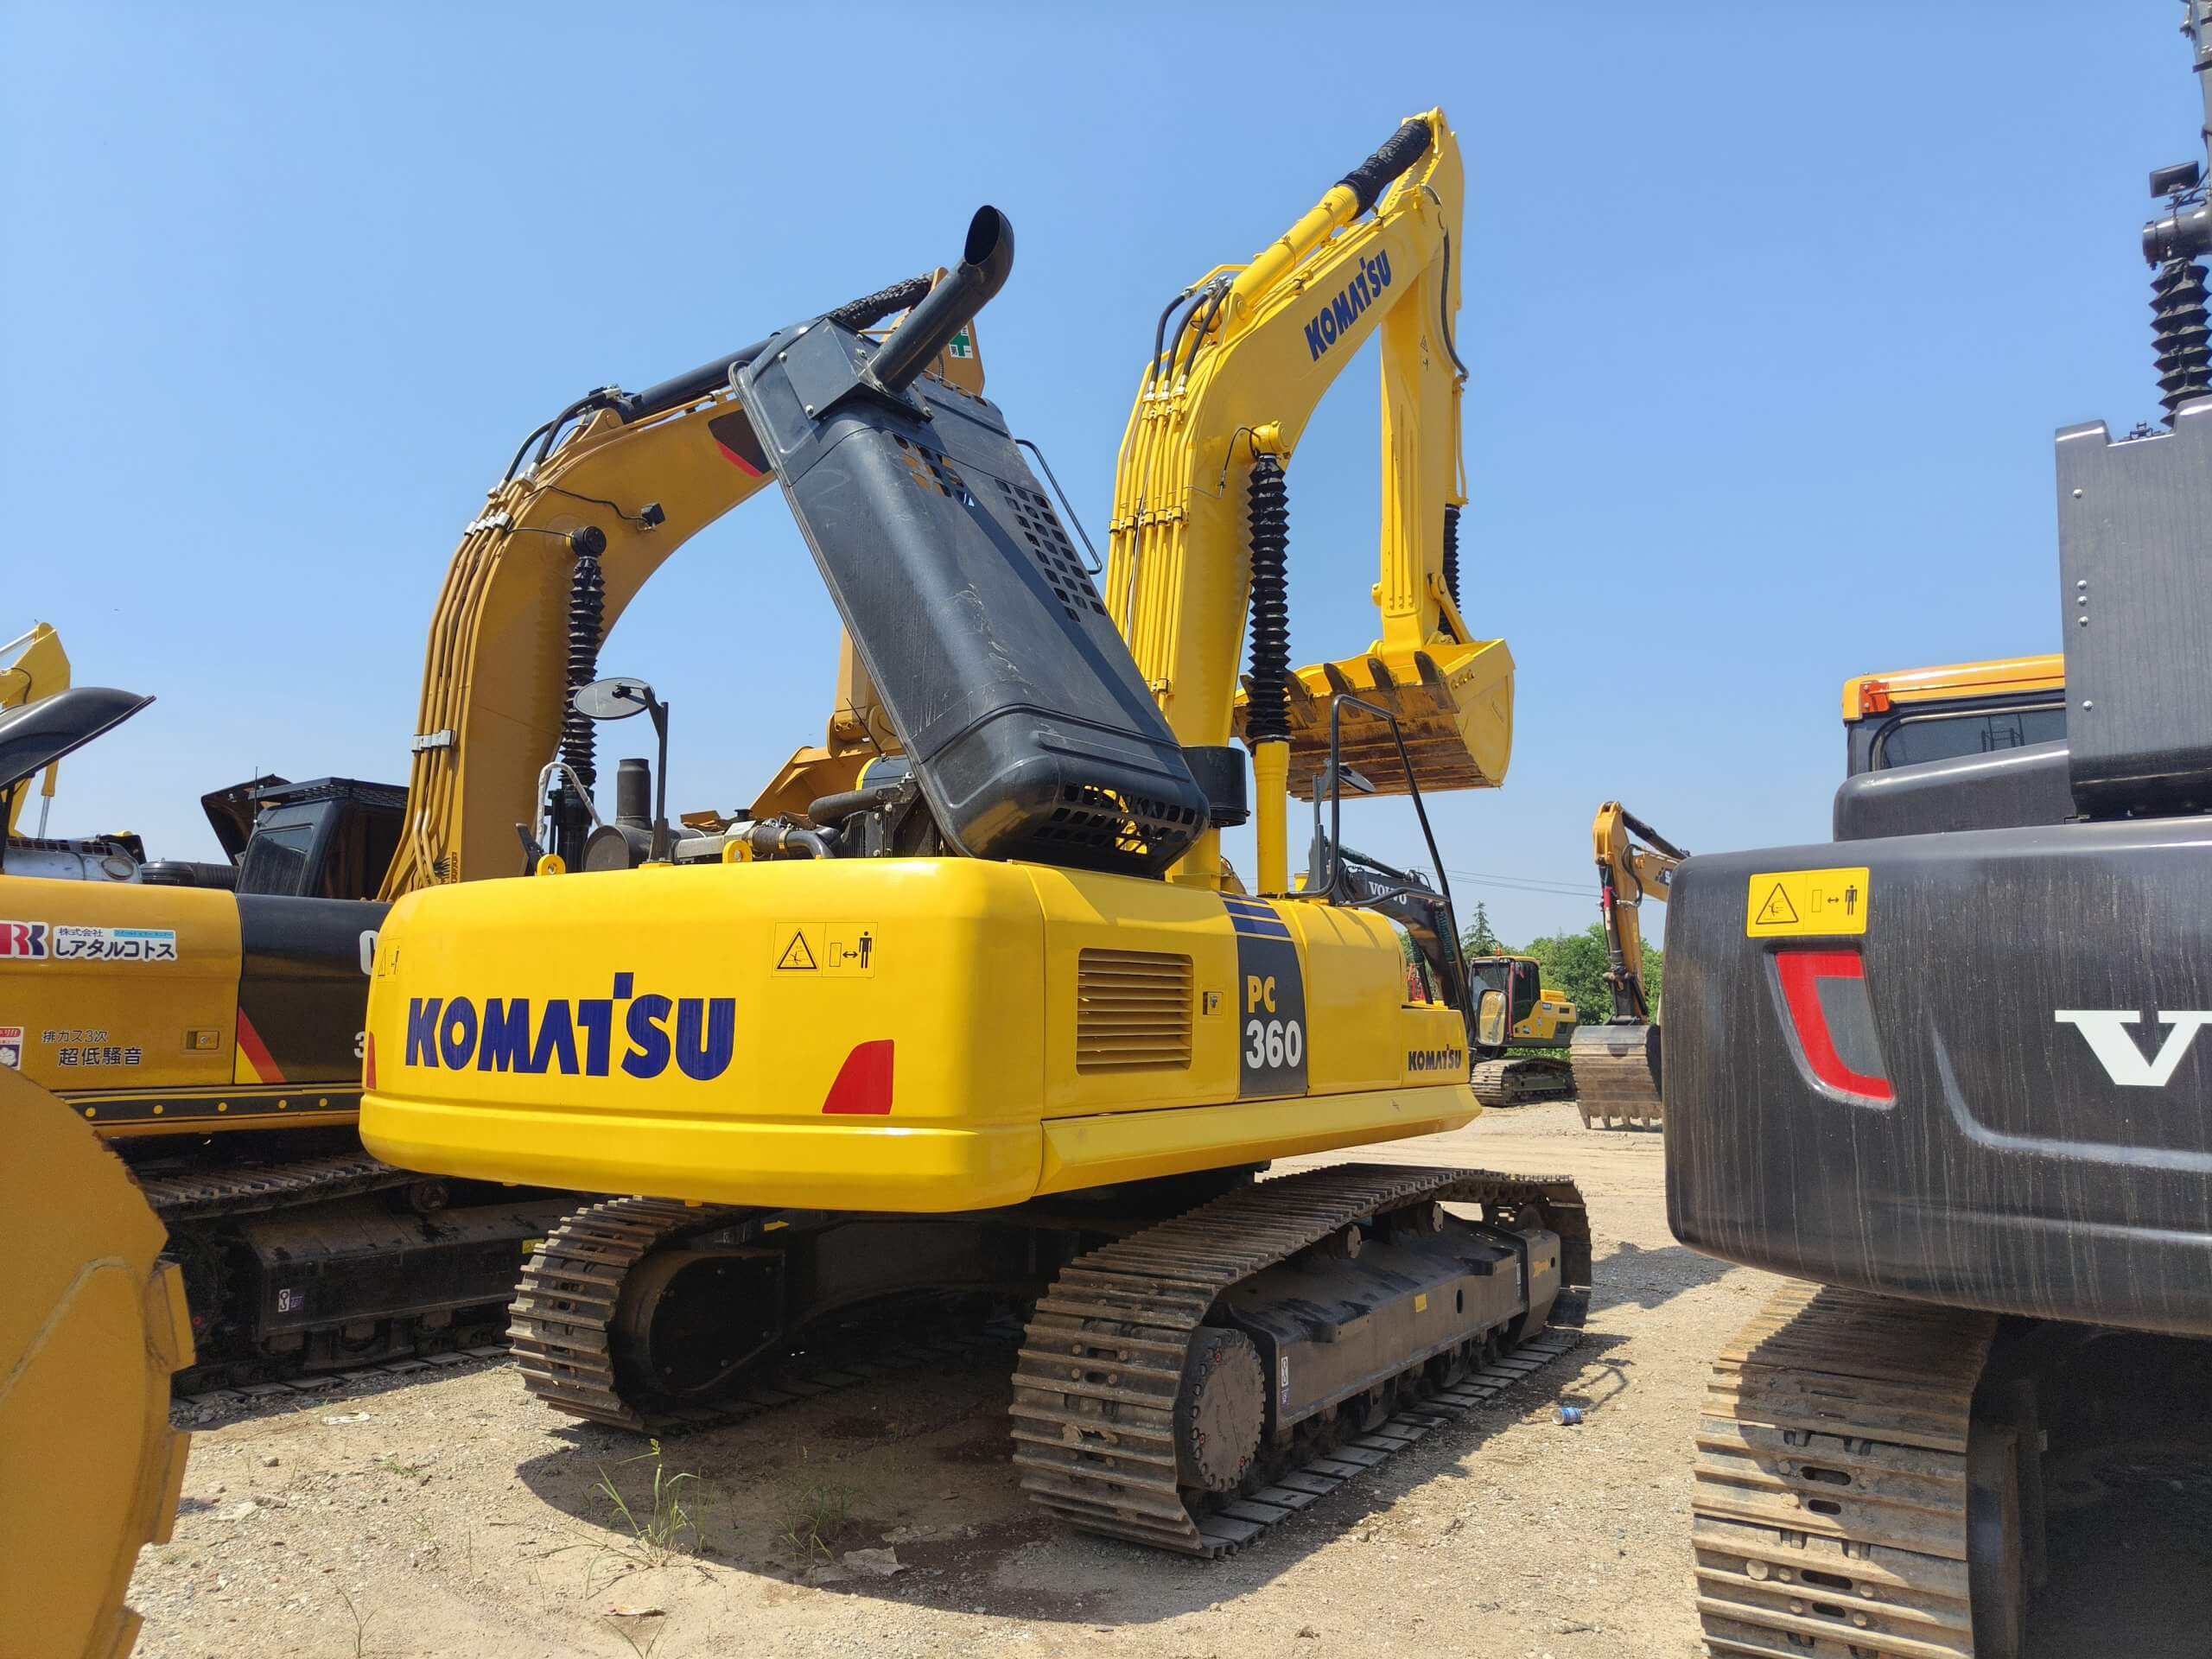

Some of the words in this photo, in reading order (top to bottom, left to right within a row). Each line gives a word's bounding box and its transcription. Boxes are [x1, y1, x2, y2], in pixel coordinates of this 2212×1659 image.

[1304, 249, 1391, 361] KOMATSU
[1247, 976, 1275, 1014] PC
[405, 972, 736, 1081] KOMATSU
[1246, 1020, 1302, 1069] 360
[58, 1047, 142, 1066] 超低騒音
[1408, 1044, 1462, 1071] KOMATSU
